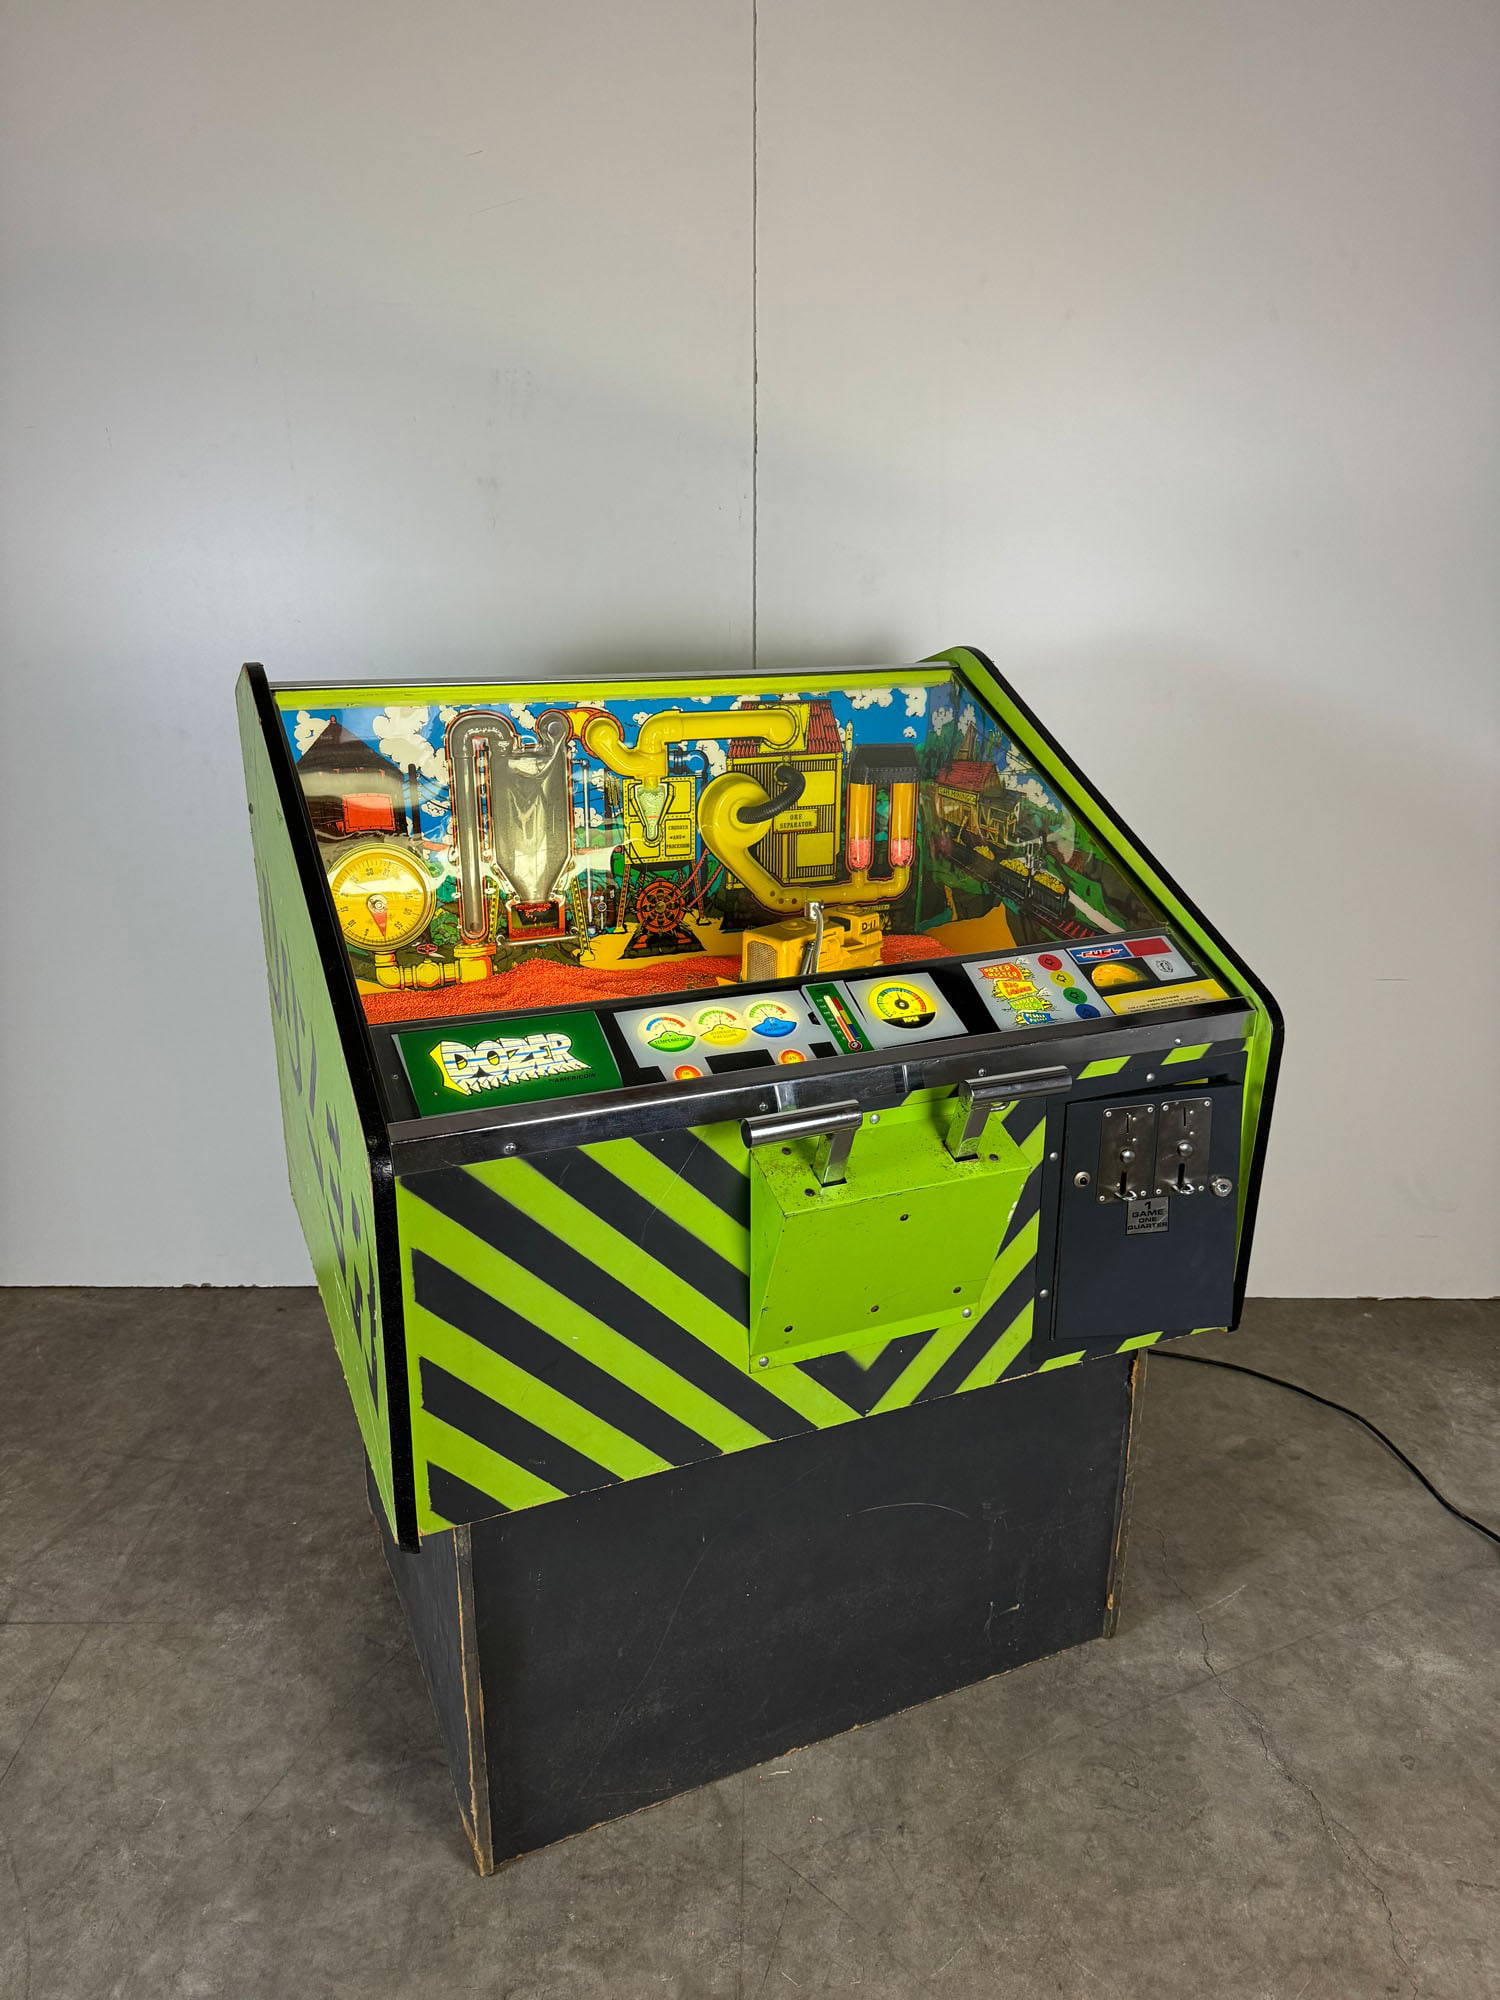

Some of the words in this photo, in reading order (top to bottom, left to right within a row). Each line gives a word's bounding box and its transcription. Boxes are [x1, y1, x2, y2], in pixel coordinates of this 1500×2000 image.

[779, 821, 812, 829] SEPARATOR
[1082, 947, 1116, 958] FUEL
[654, 1036, 689, 1045] TEMPERATURE
[430, 1033, 592, 1096] DOZER
[555, 1072, 597, 1083] AMERICOIN
[1144, 1201, 1151, 1210] 1
[1132, 1208, 1164, 1218] GAME
[1138, 1216, 1158, 1224] ONE
[1127, 1221, 1168, 1231] QUARTER
